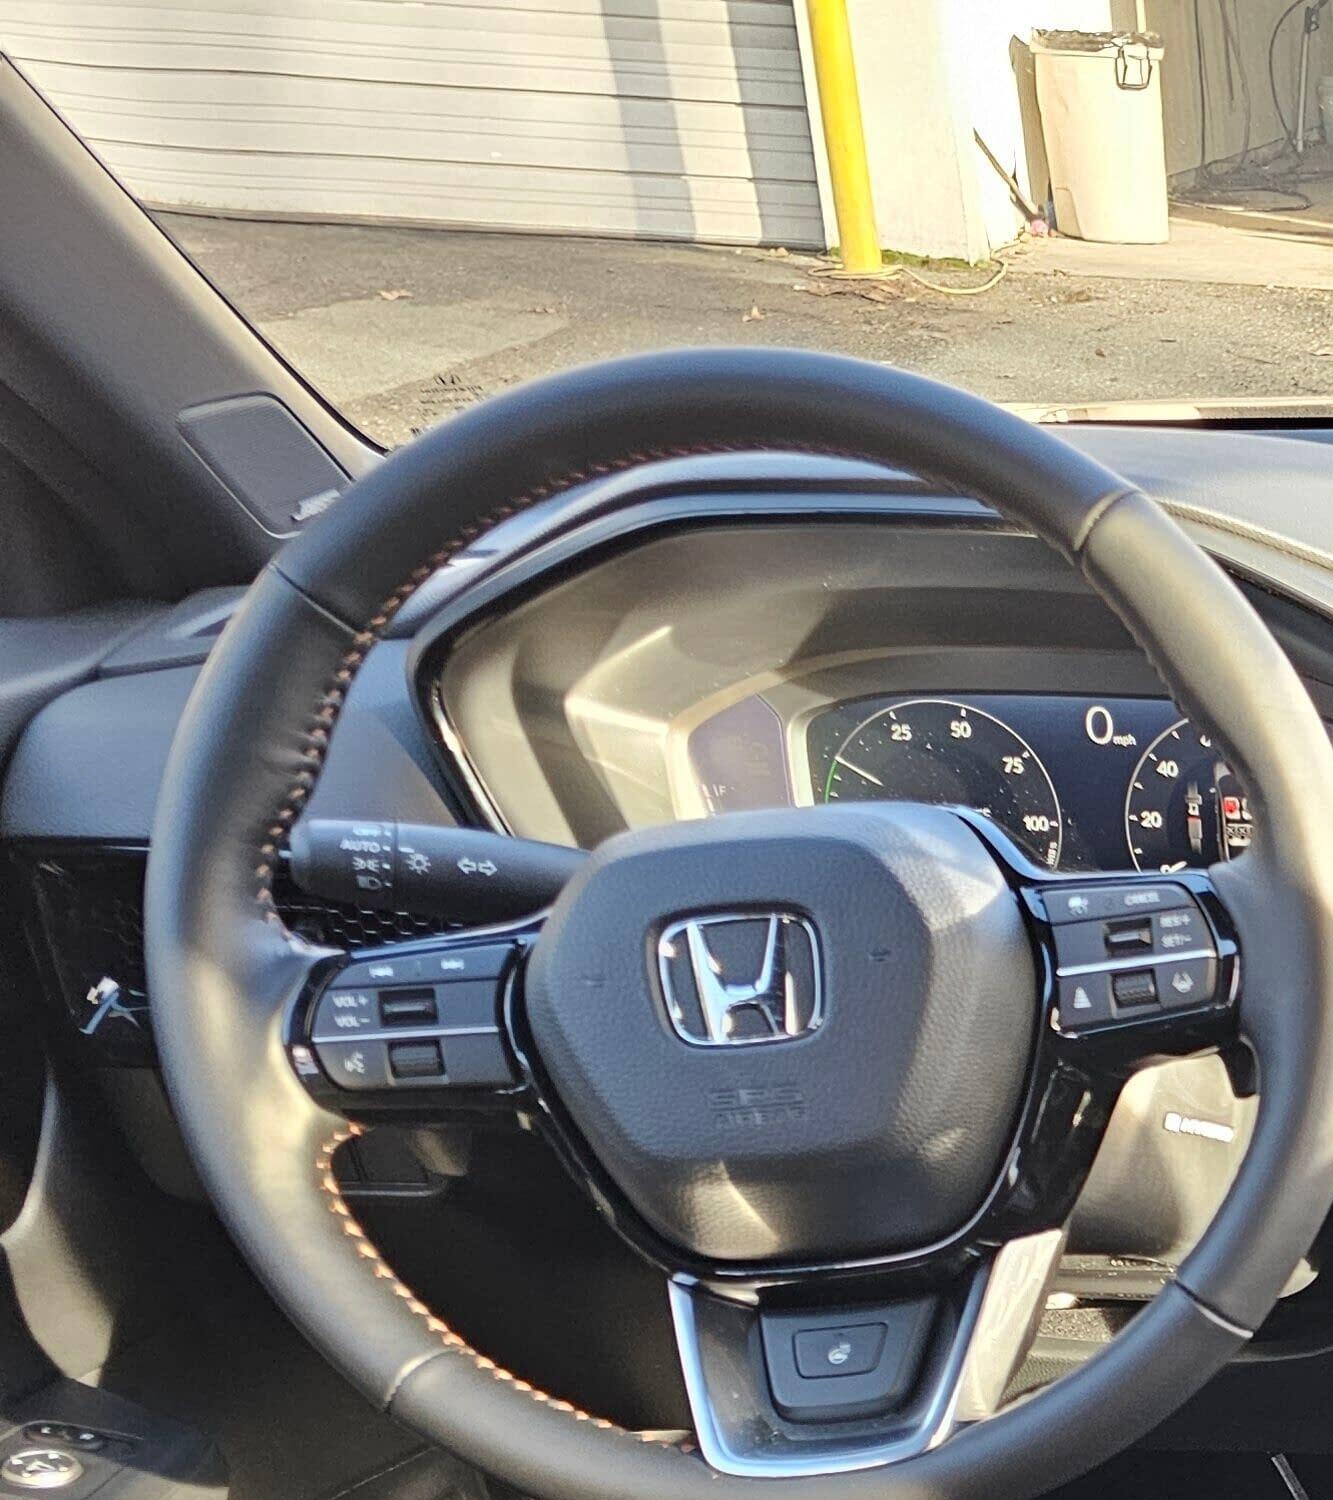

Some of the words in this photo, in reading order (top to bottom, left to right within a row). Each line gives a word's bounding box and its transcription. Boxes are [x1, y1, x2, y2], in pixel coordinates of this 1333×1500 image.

[890, 723, 913, 742] 25
[951, 720, 972, 739] 50
[1085, 705, 1114, 746] 0
[1113, 733, 1137, 748] mph
[1002, 756, 1025, 775] 75
[1156, 760, 1179, 778] 40
[1022, 815, 1050, 832] 100
[1140, 810, 1163, 829] 20
